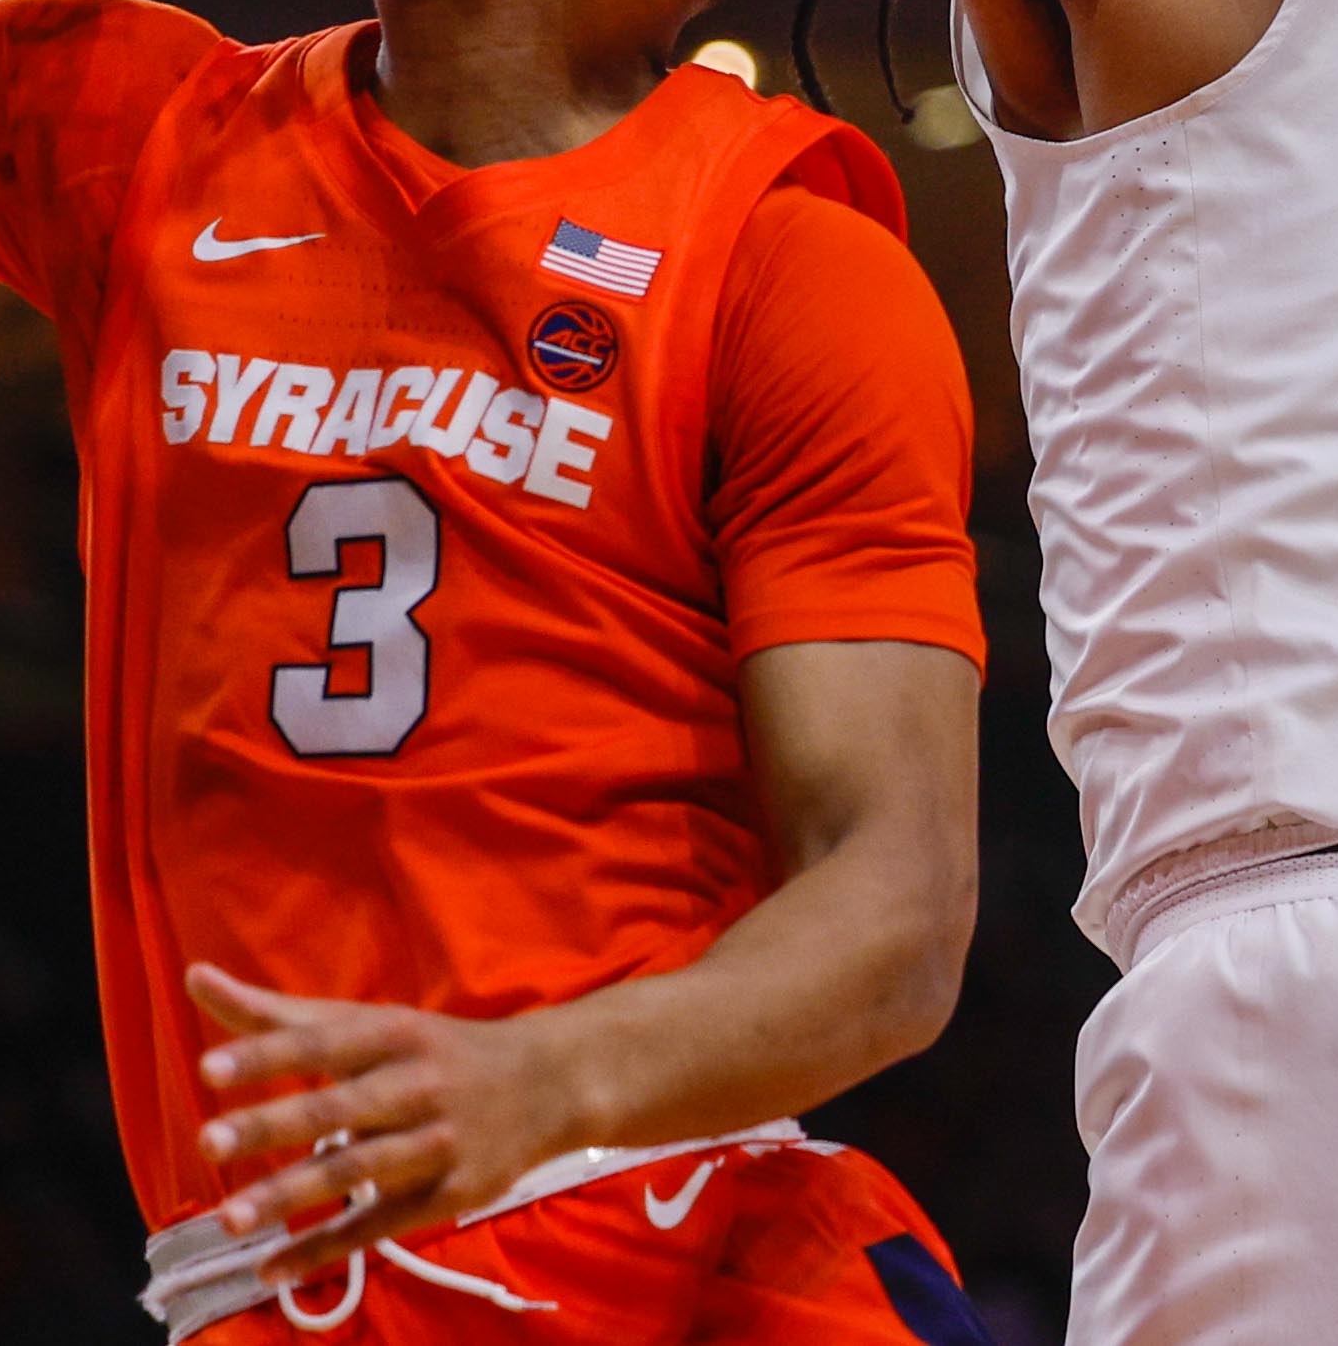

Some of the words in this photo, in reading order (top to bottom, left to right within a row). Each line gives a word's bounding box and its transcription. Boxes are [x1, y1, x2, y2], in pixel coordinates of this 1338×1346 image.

[542, 328, 613, 360] ACC
[162, 349, 613, 509] SYRACUSE
[271, 474, 441, 757] 3
